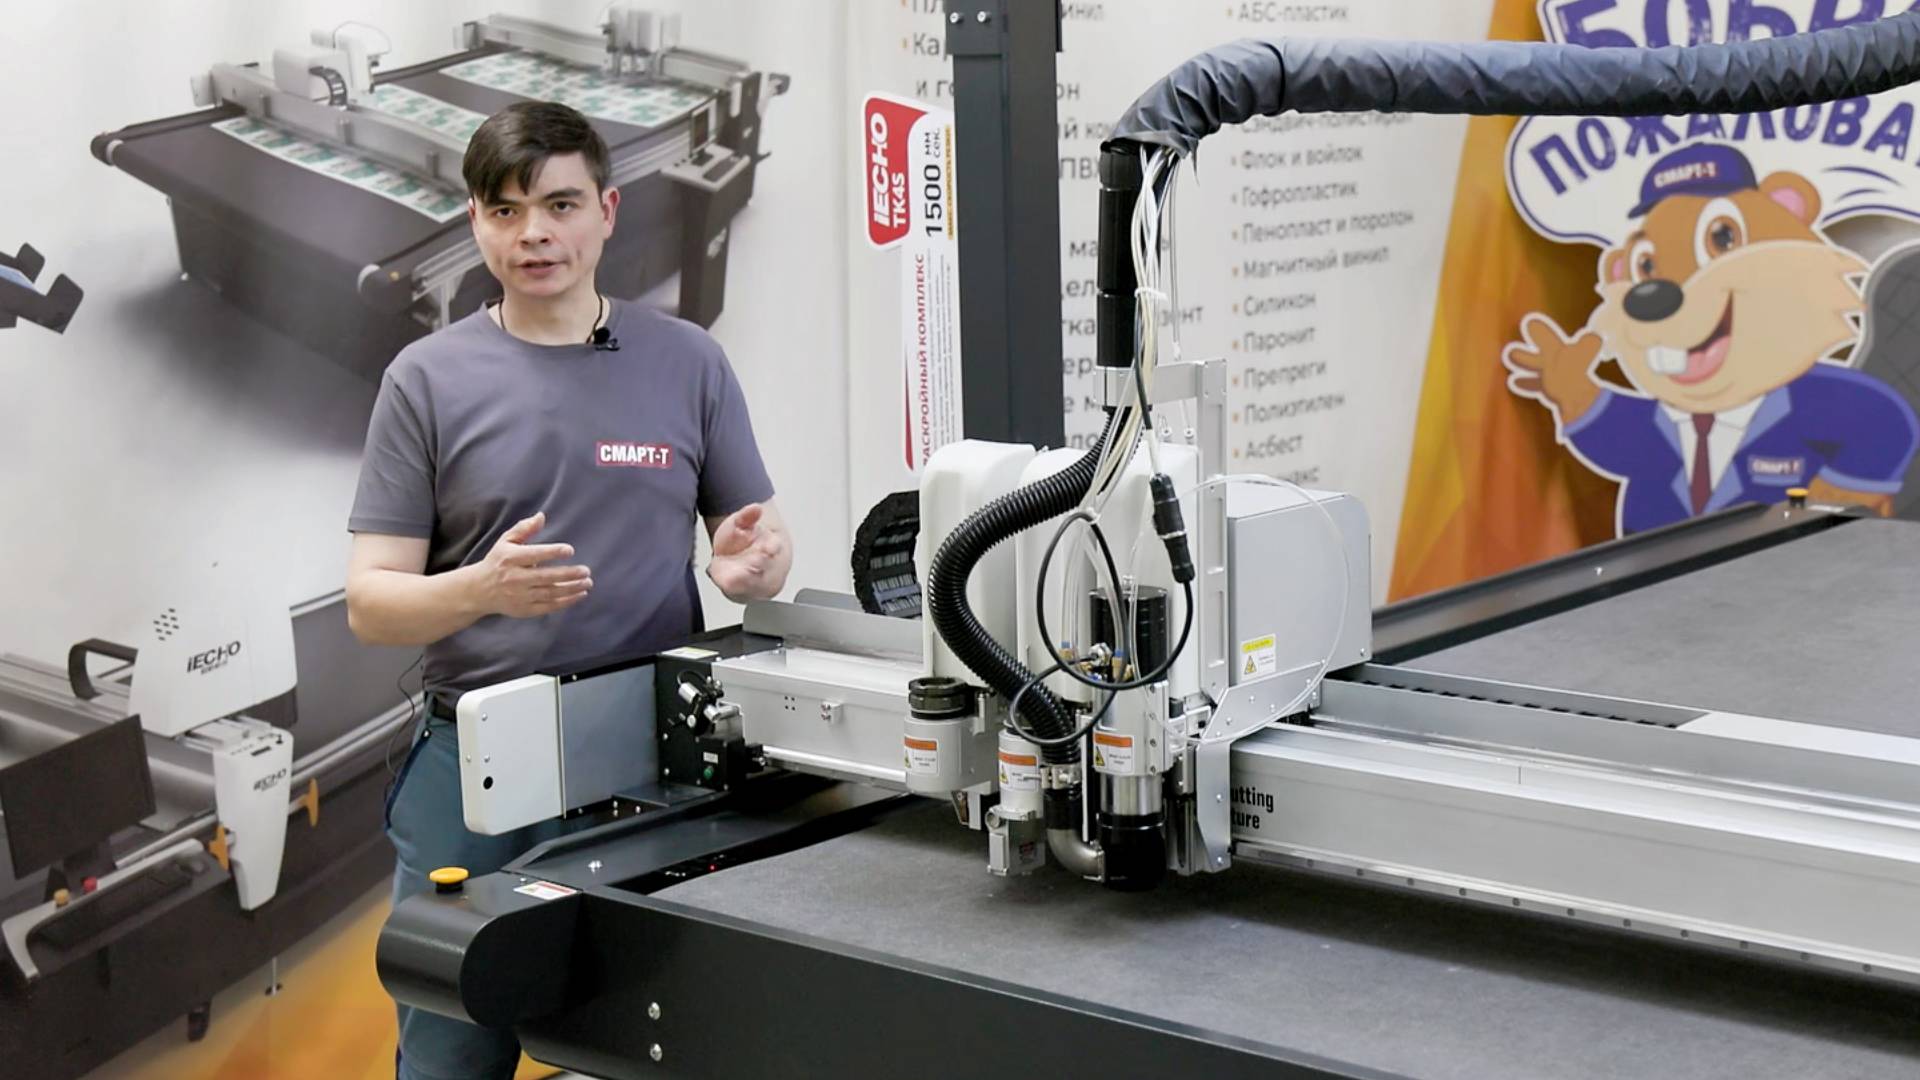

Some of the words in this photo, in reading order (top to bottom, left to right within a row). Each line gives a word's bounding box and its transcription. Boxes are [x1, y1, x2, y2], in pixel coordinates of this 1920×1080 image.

[1530, 95, 1920, 196] ПОЖАЛОВА
[870, 112, 890, 228] IECHO
[924, 164, 943, 238] 1500
[1241, 182, 1358, 209] Гофропластик
[1241, 217, 1330, 244] Пенопласт
[1243, 249, 1338, 279] Магнитный
[914, 254, 927, 345] КОМПЛЕКС
[1244, 293, 1317, 317] Силикон
[1244, 327, 1316, 353] Паронит
[1243, 360, 1327, 391] Препреги
[1243, 394, 1345, 425] Полиэтилен
[600, 444, 669, 465] СМАРТ-Т
[1245, 434, 1303, 460] Асбест
[1230, 786, 1274, 813] utting
[1230, 807, 1260, 829] ture
